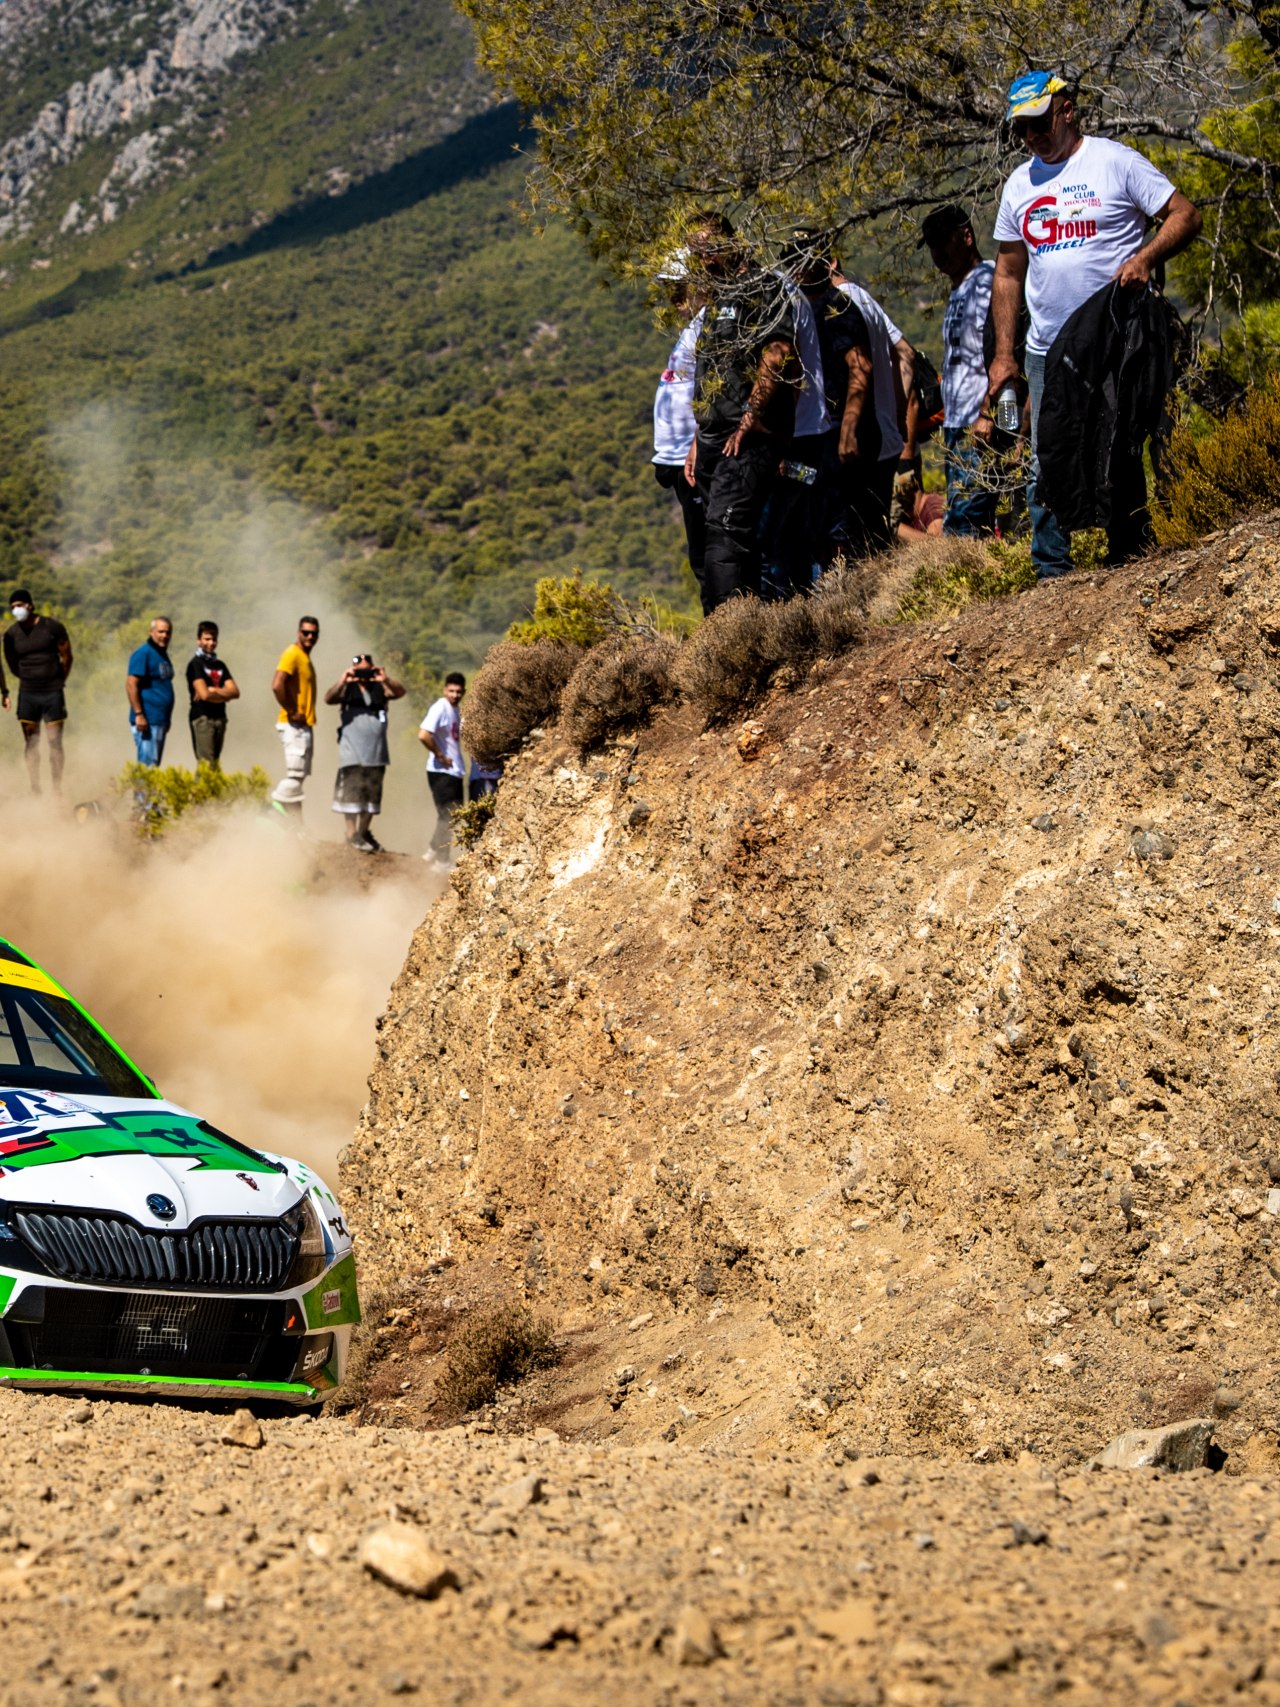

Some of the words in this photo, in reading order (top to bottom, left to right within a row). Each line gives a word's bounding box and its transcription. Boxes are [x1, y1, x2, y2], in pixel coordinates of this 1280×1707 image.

[1062, 184, 1088, 193] MOTO
[1074, 191, 1095, 199] CLUB
[1022, 196, 1097, 249] Group
